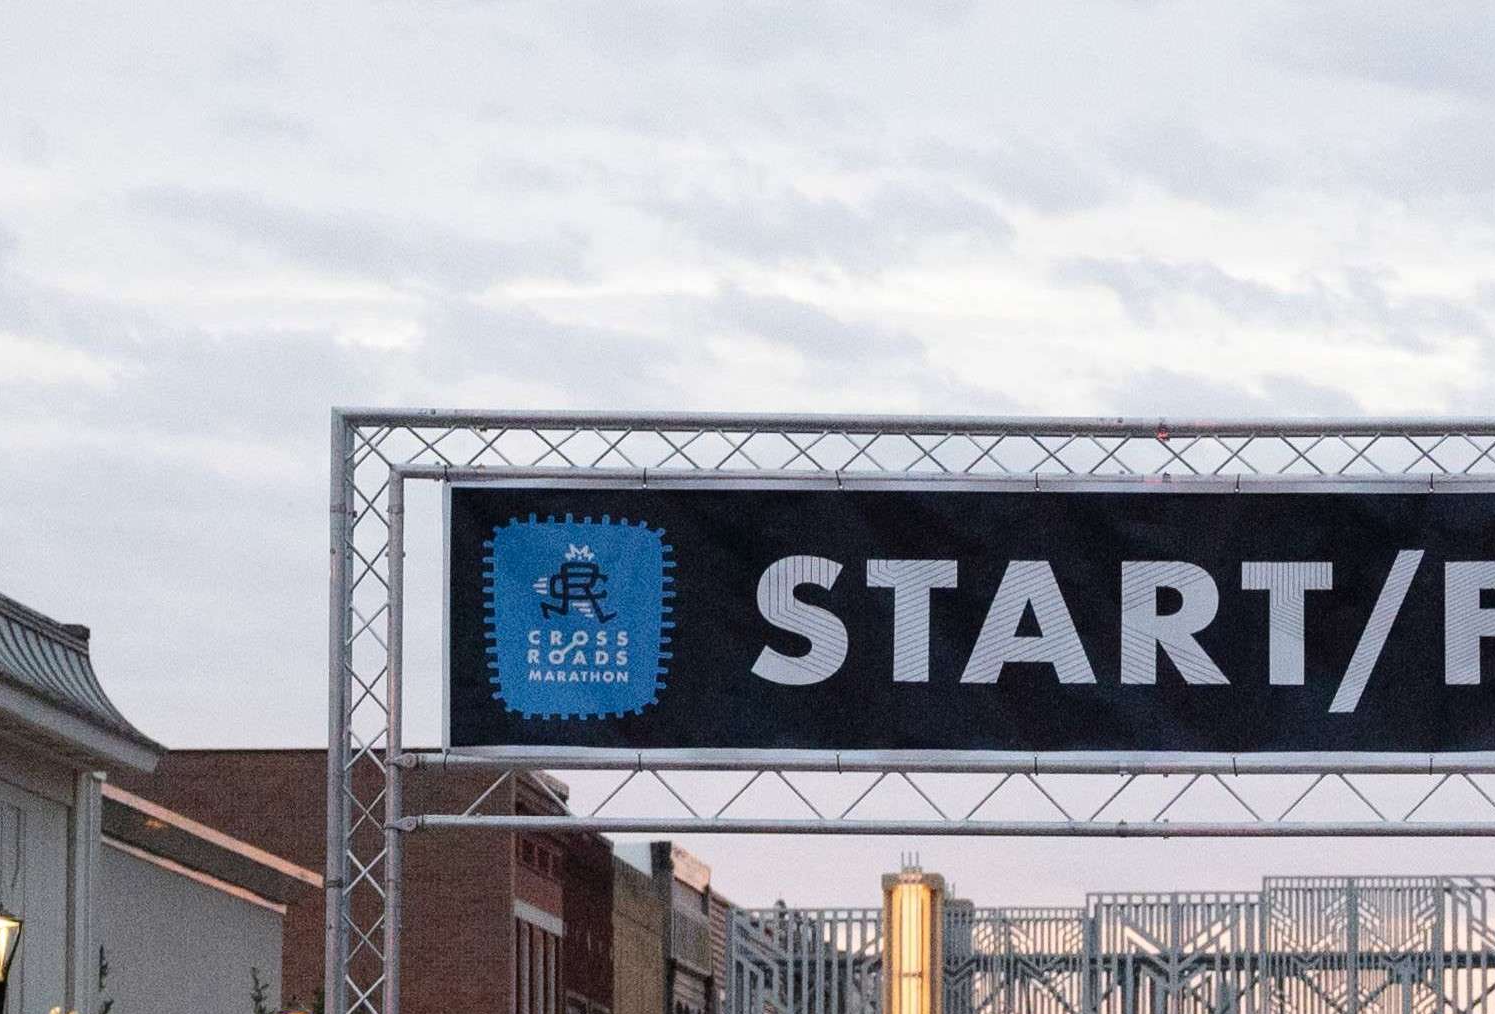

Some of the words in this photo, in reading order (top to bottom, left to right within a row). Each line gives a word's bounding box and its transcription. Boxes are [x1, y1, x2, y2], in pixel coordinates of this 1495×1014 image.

[527, 630, 629, 646] CROSS
[527, 649, 629, 666] ROADS
[529, 670, 629, 683] MARATHON
